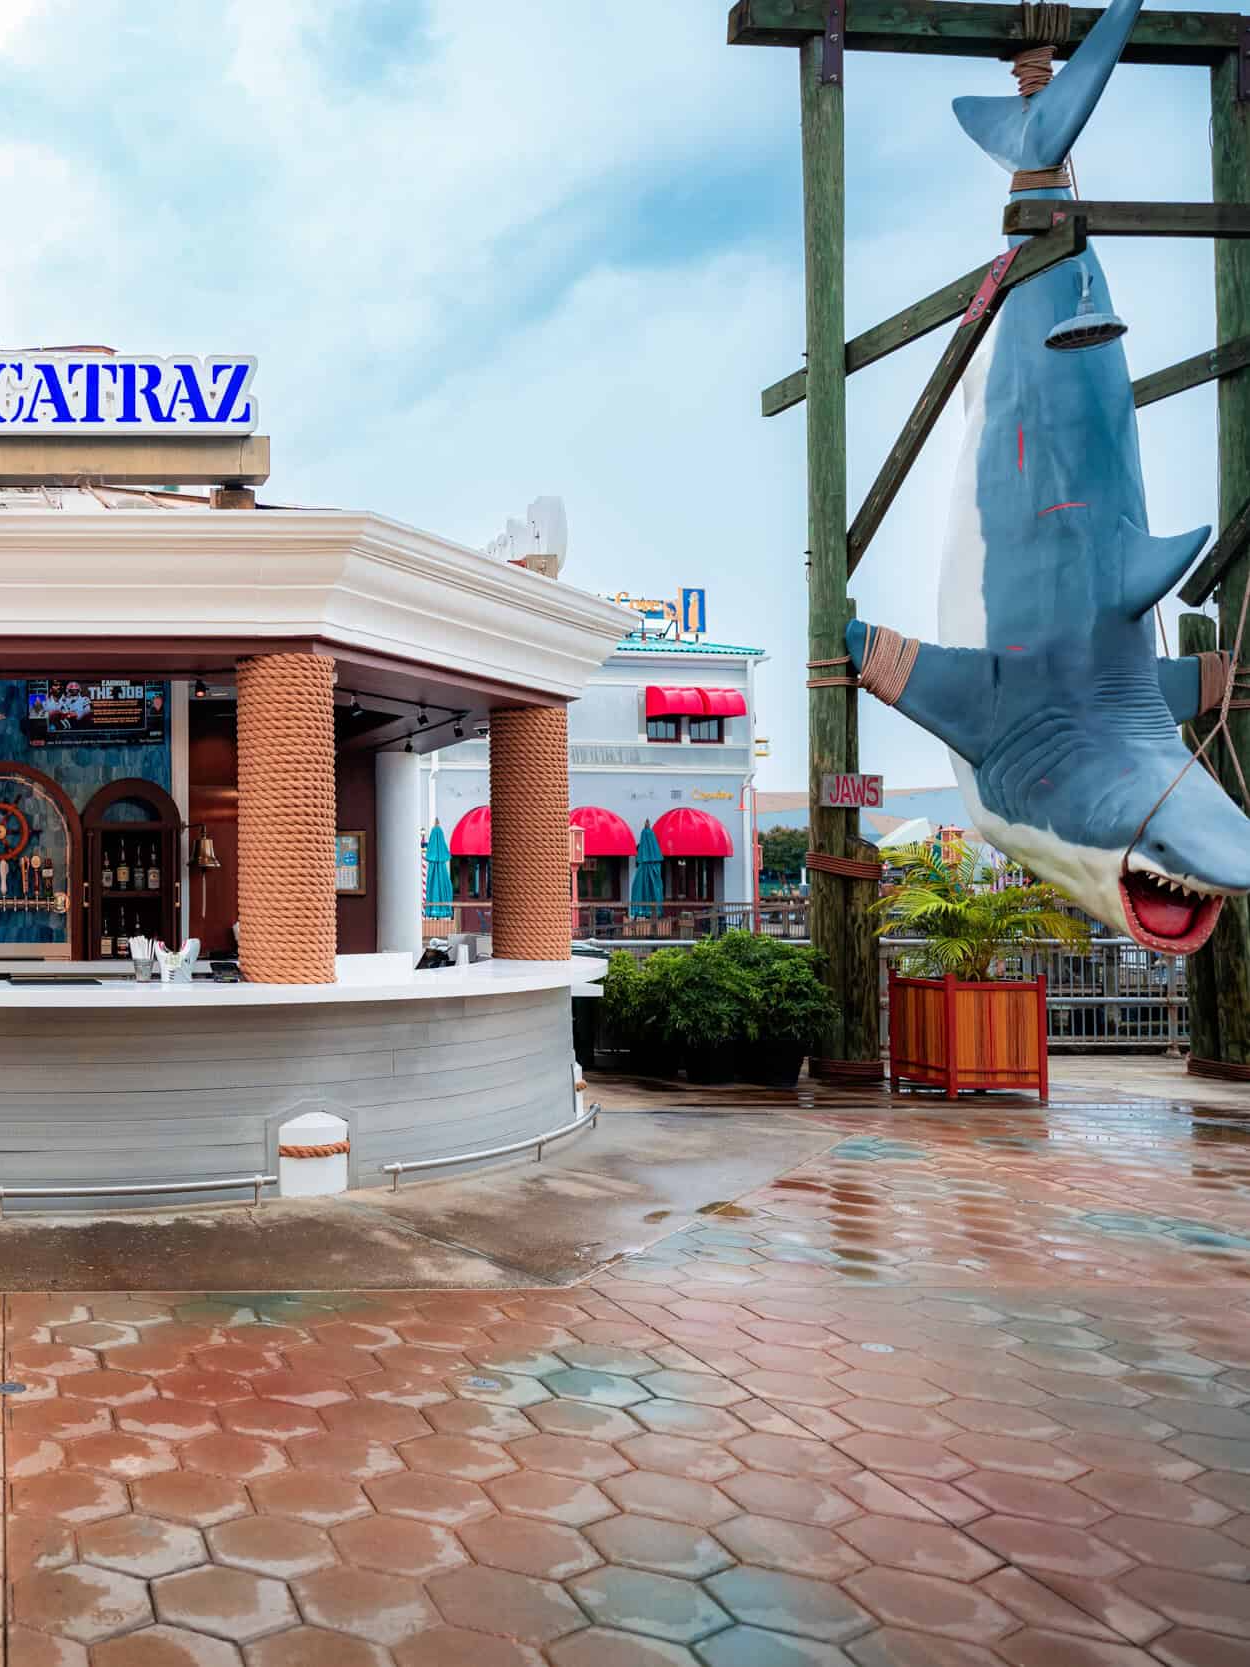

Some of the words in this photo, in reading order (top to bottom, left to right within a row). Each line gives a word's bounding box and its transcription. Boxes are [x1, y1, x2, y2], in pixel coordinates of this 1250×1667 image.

[88, 686, 114, 700] THE
[118, 686, 144, 699] JOB
[830, 775, 879, 807] JAWS
